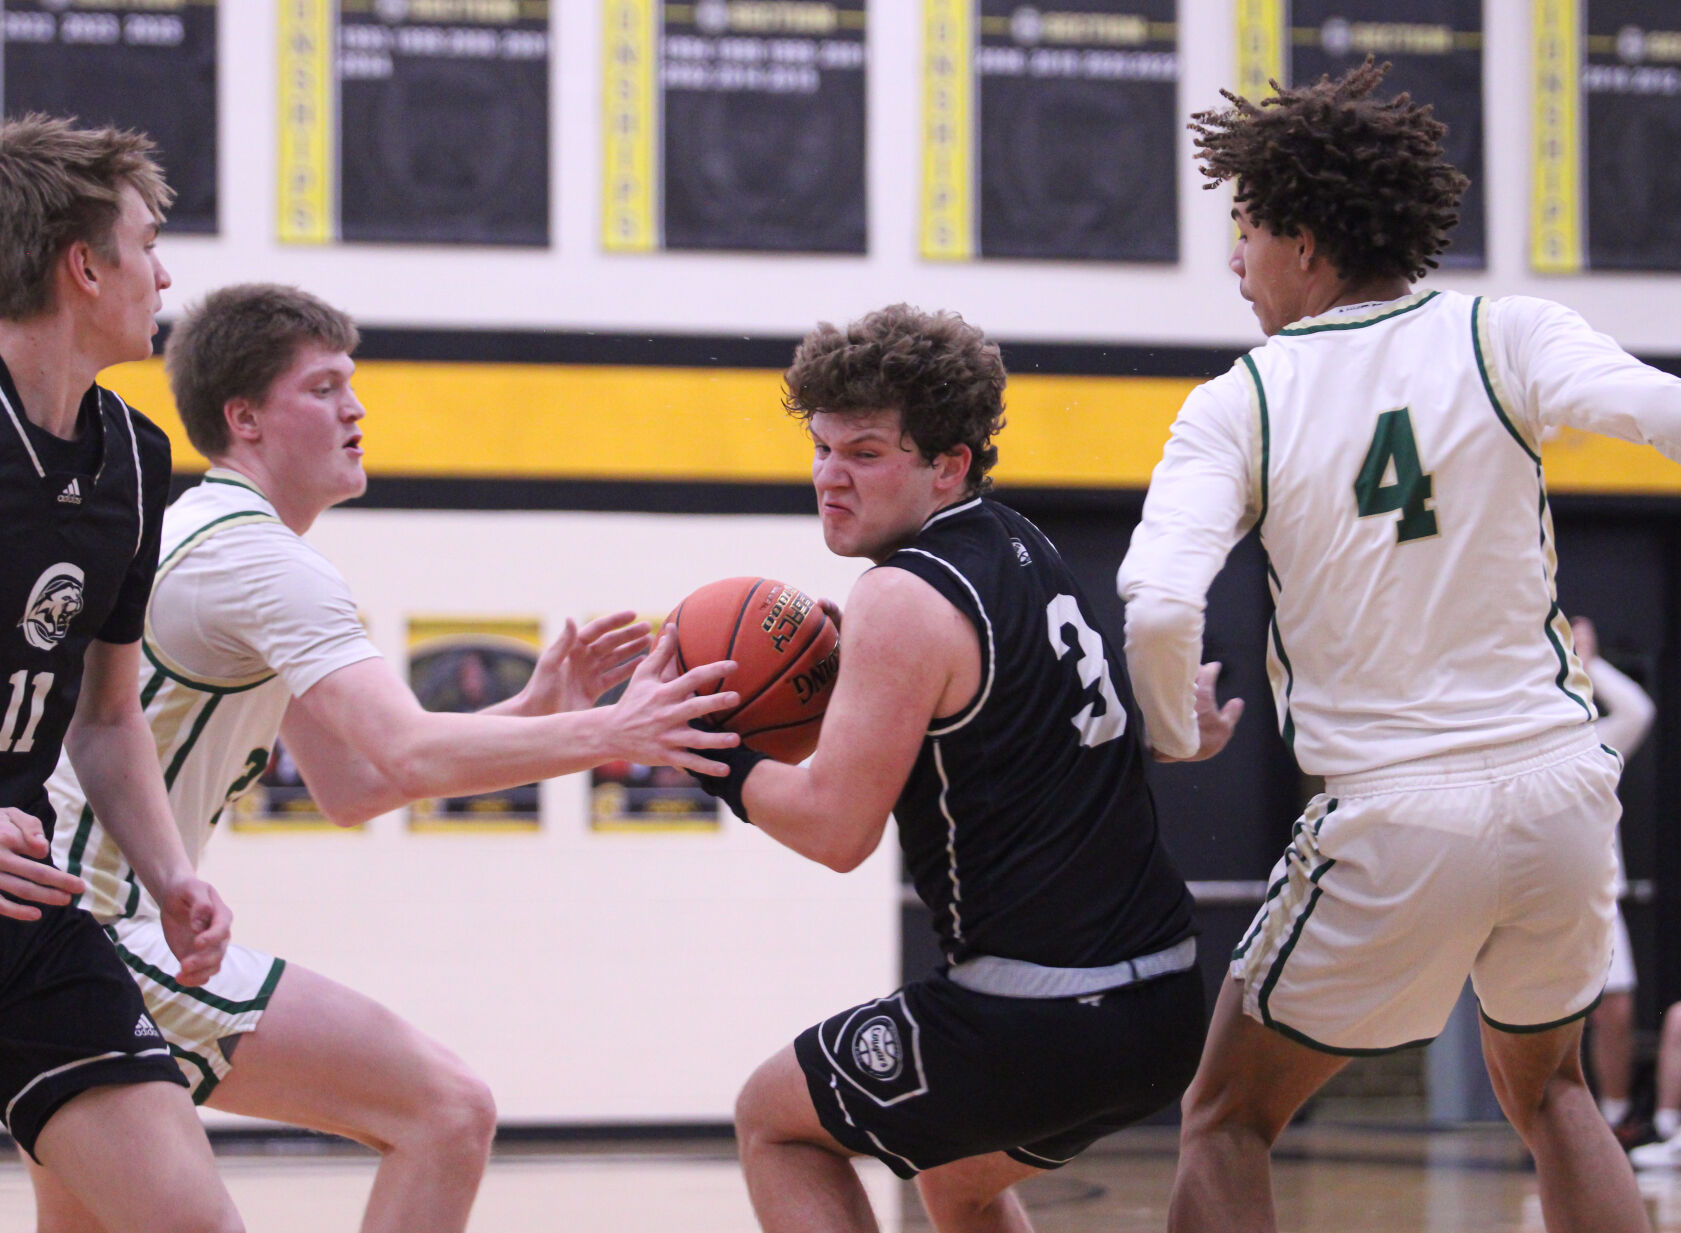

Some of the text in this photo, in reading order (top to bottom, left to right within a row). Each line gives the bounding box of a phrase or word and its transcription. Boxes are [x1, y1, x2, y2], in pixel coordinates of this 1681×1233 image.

[57, 495, 82, 505] adidas
[1355, 405, 1442, 544] 4
[762, 587, 798, 632] 1000
[771, 592, 815, 653] EGACY
[793, 642, 840, 704] DING
[1047, 593, 1127, 749] 3
[0, 669, 55, 753] 11
[135, 1027, 159, 1037] adidas
